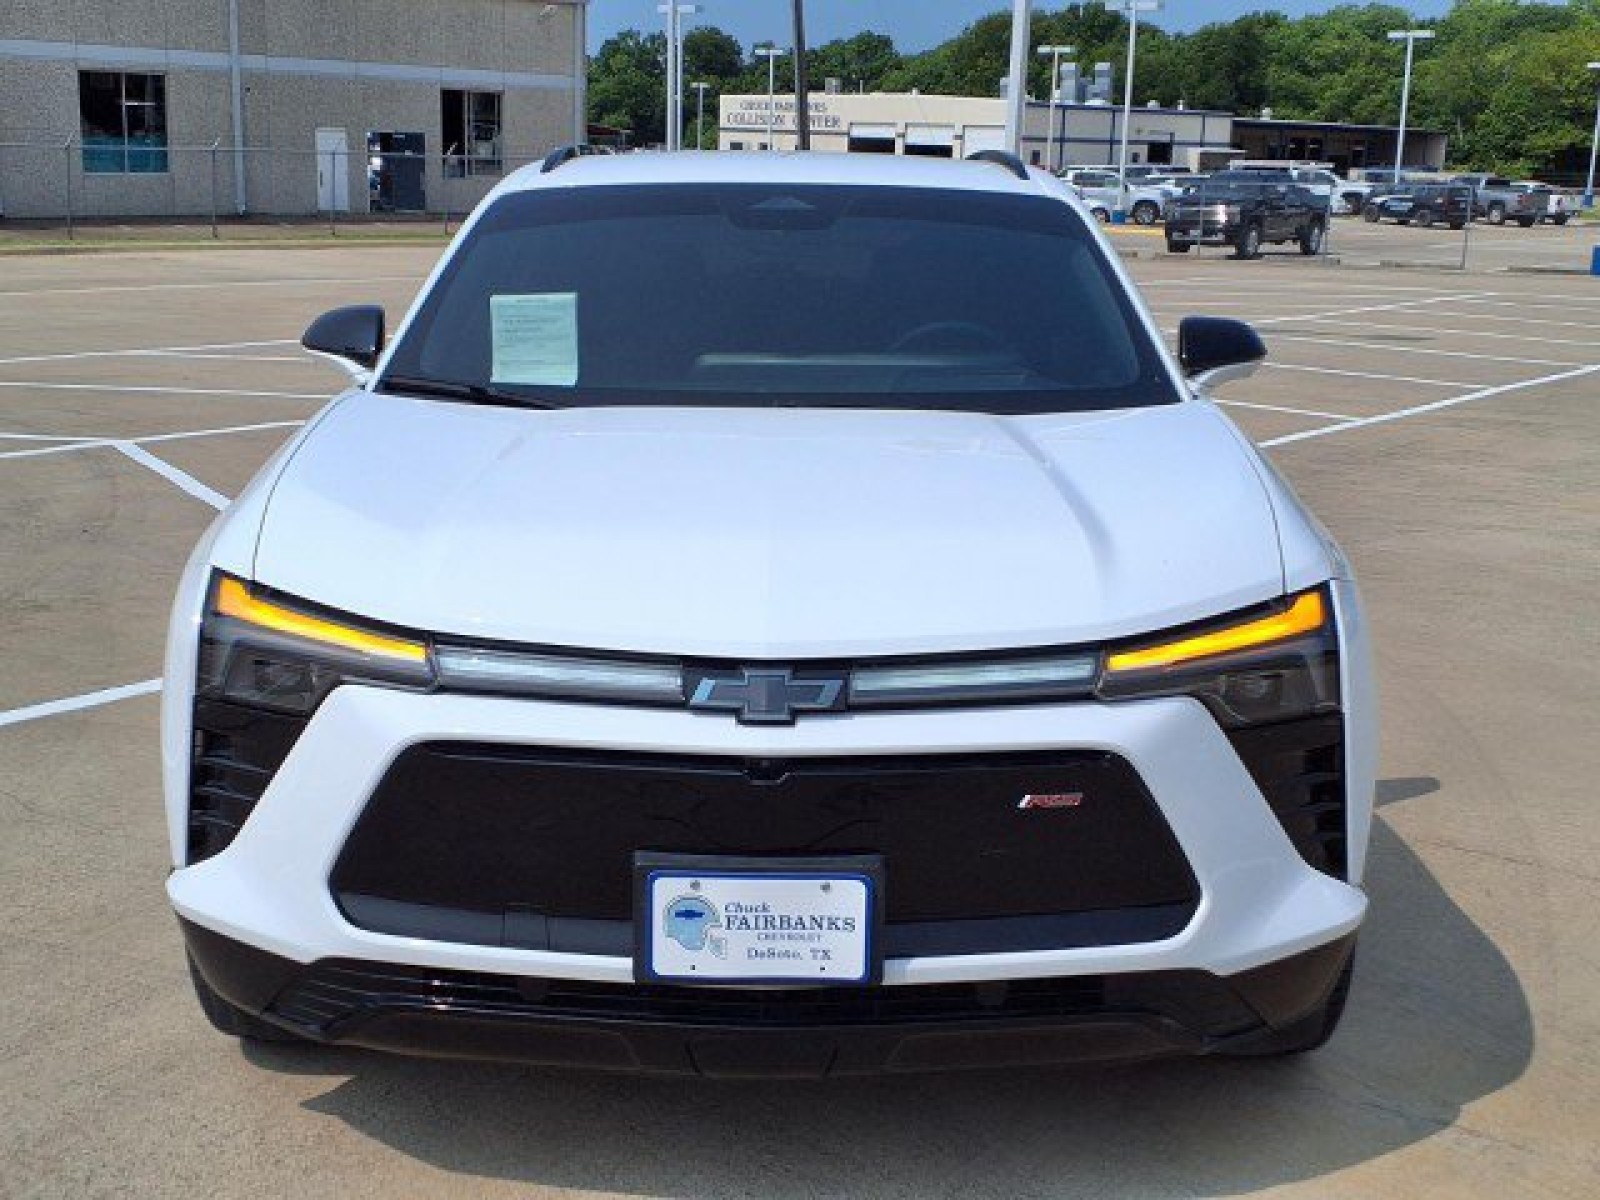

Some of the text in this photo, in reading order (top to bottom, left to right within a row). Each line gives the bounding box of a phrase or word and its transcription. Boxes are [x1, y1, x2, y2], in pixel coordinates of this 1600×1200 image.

[792, 114, 841, 128] CNTER
[724, 902, 771, 913] Chuck
[724, 915, 856, 932] FAIRBANKS
[757, 932, 821, 941] CHEVROLET
[810, 948, 833, 960] TX
